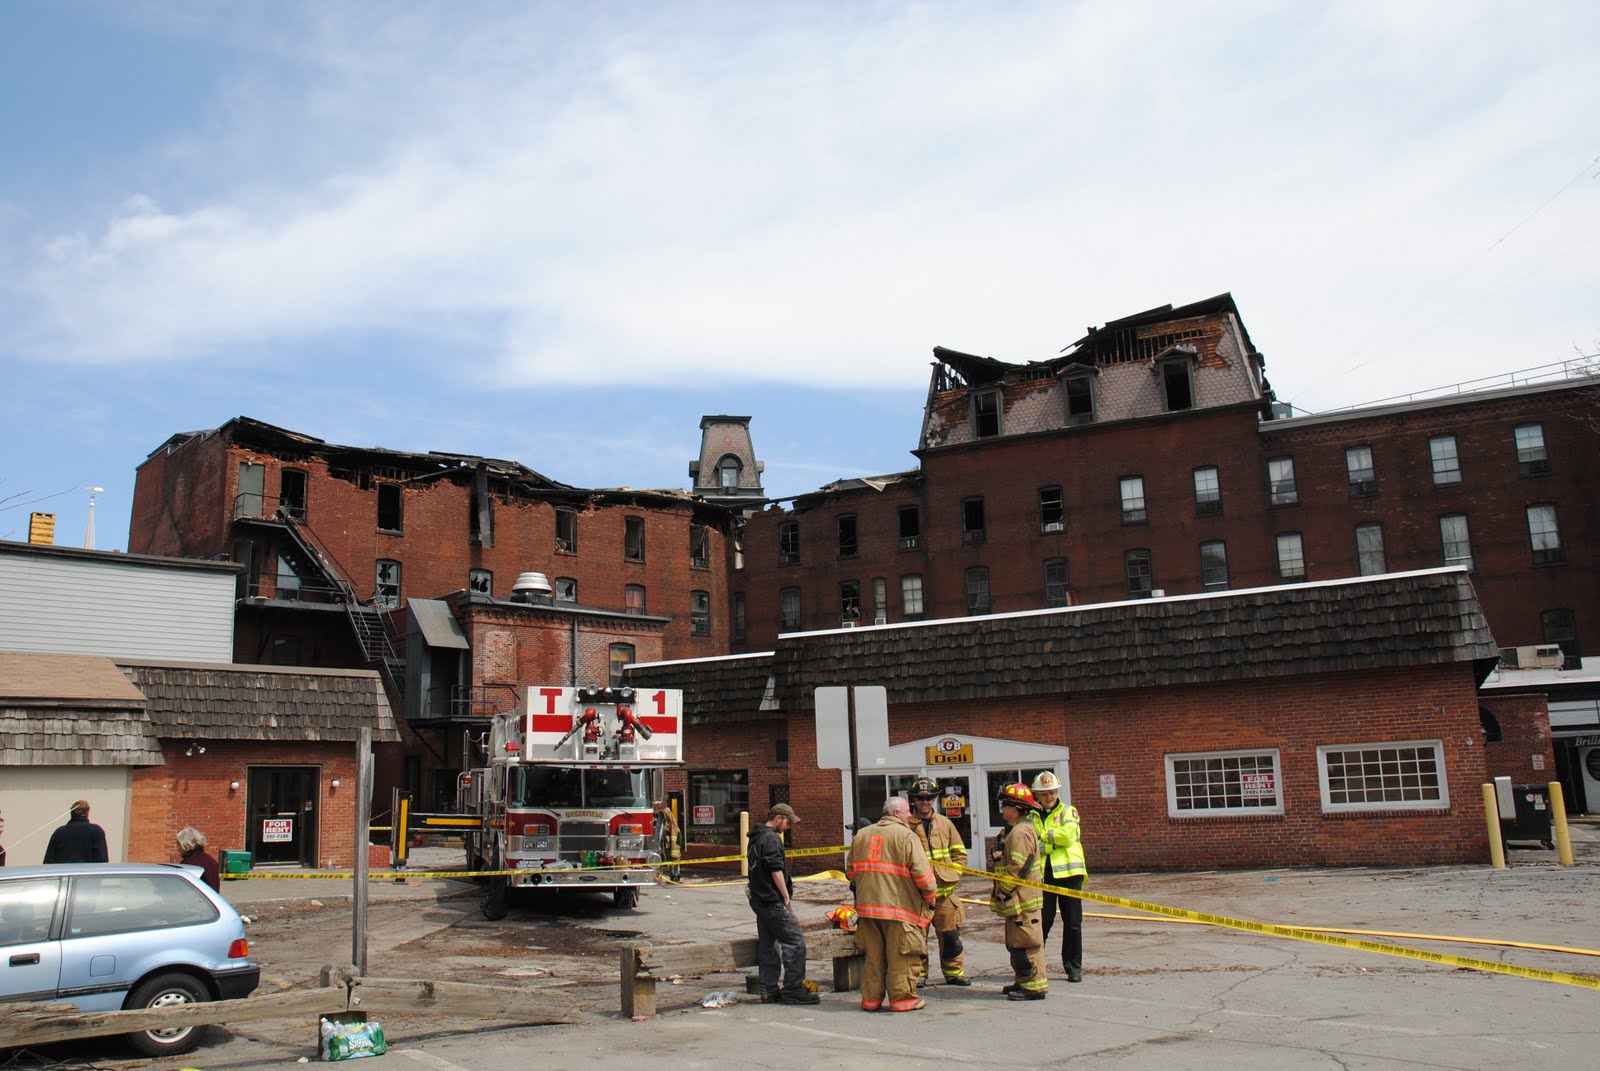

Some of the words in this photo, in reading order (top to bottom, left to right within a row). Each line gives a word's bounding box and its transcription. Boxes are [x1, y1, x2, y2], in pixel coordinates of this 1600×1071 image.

[540, 688, 562, 714] T
[652, 690, 666, 714] 1
[936, 742, 961, 752] R&B
[934, 754, 968, 763] Deli
